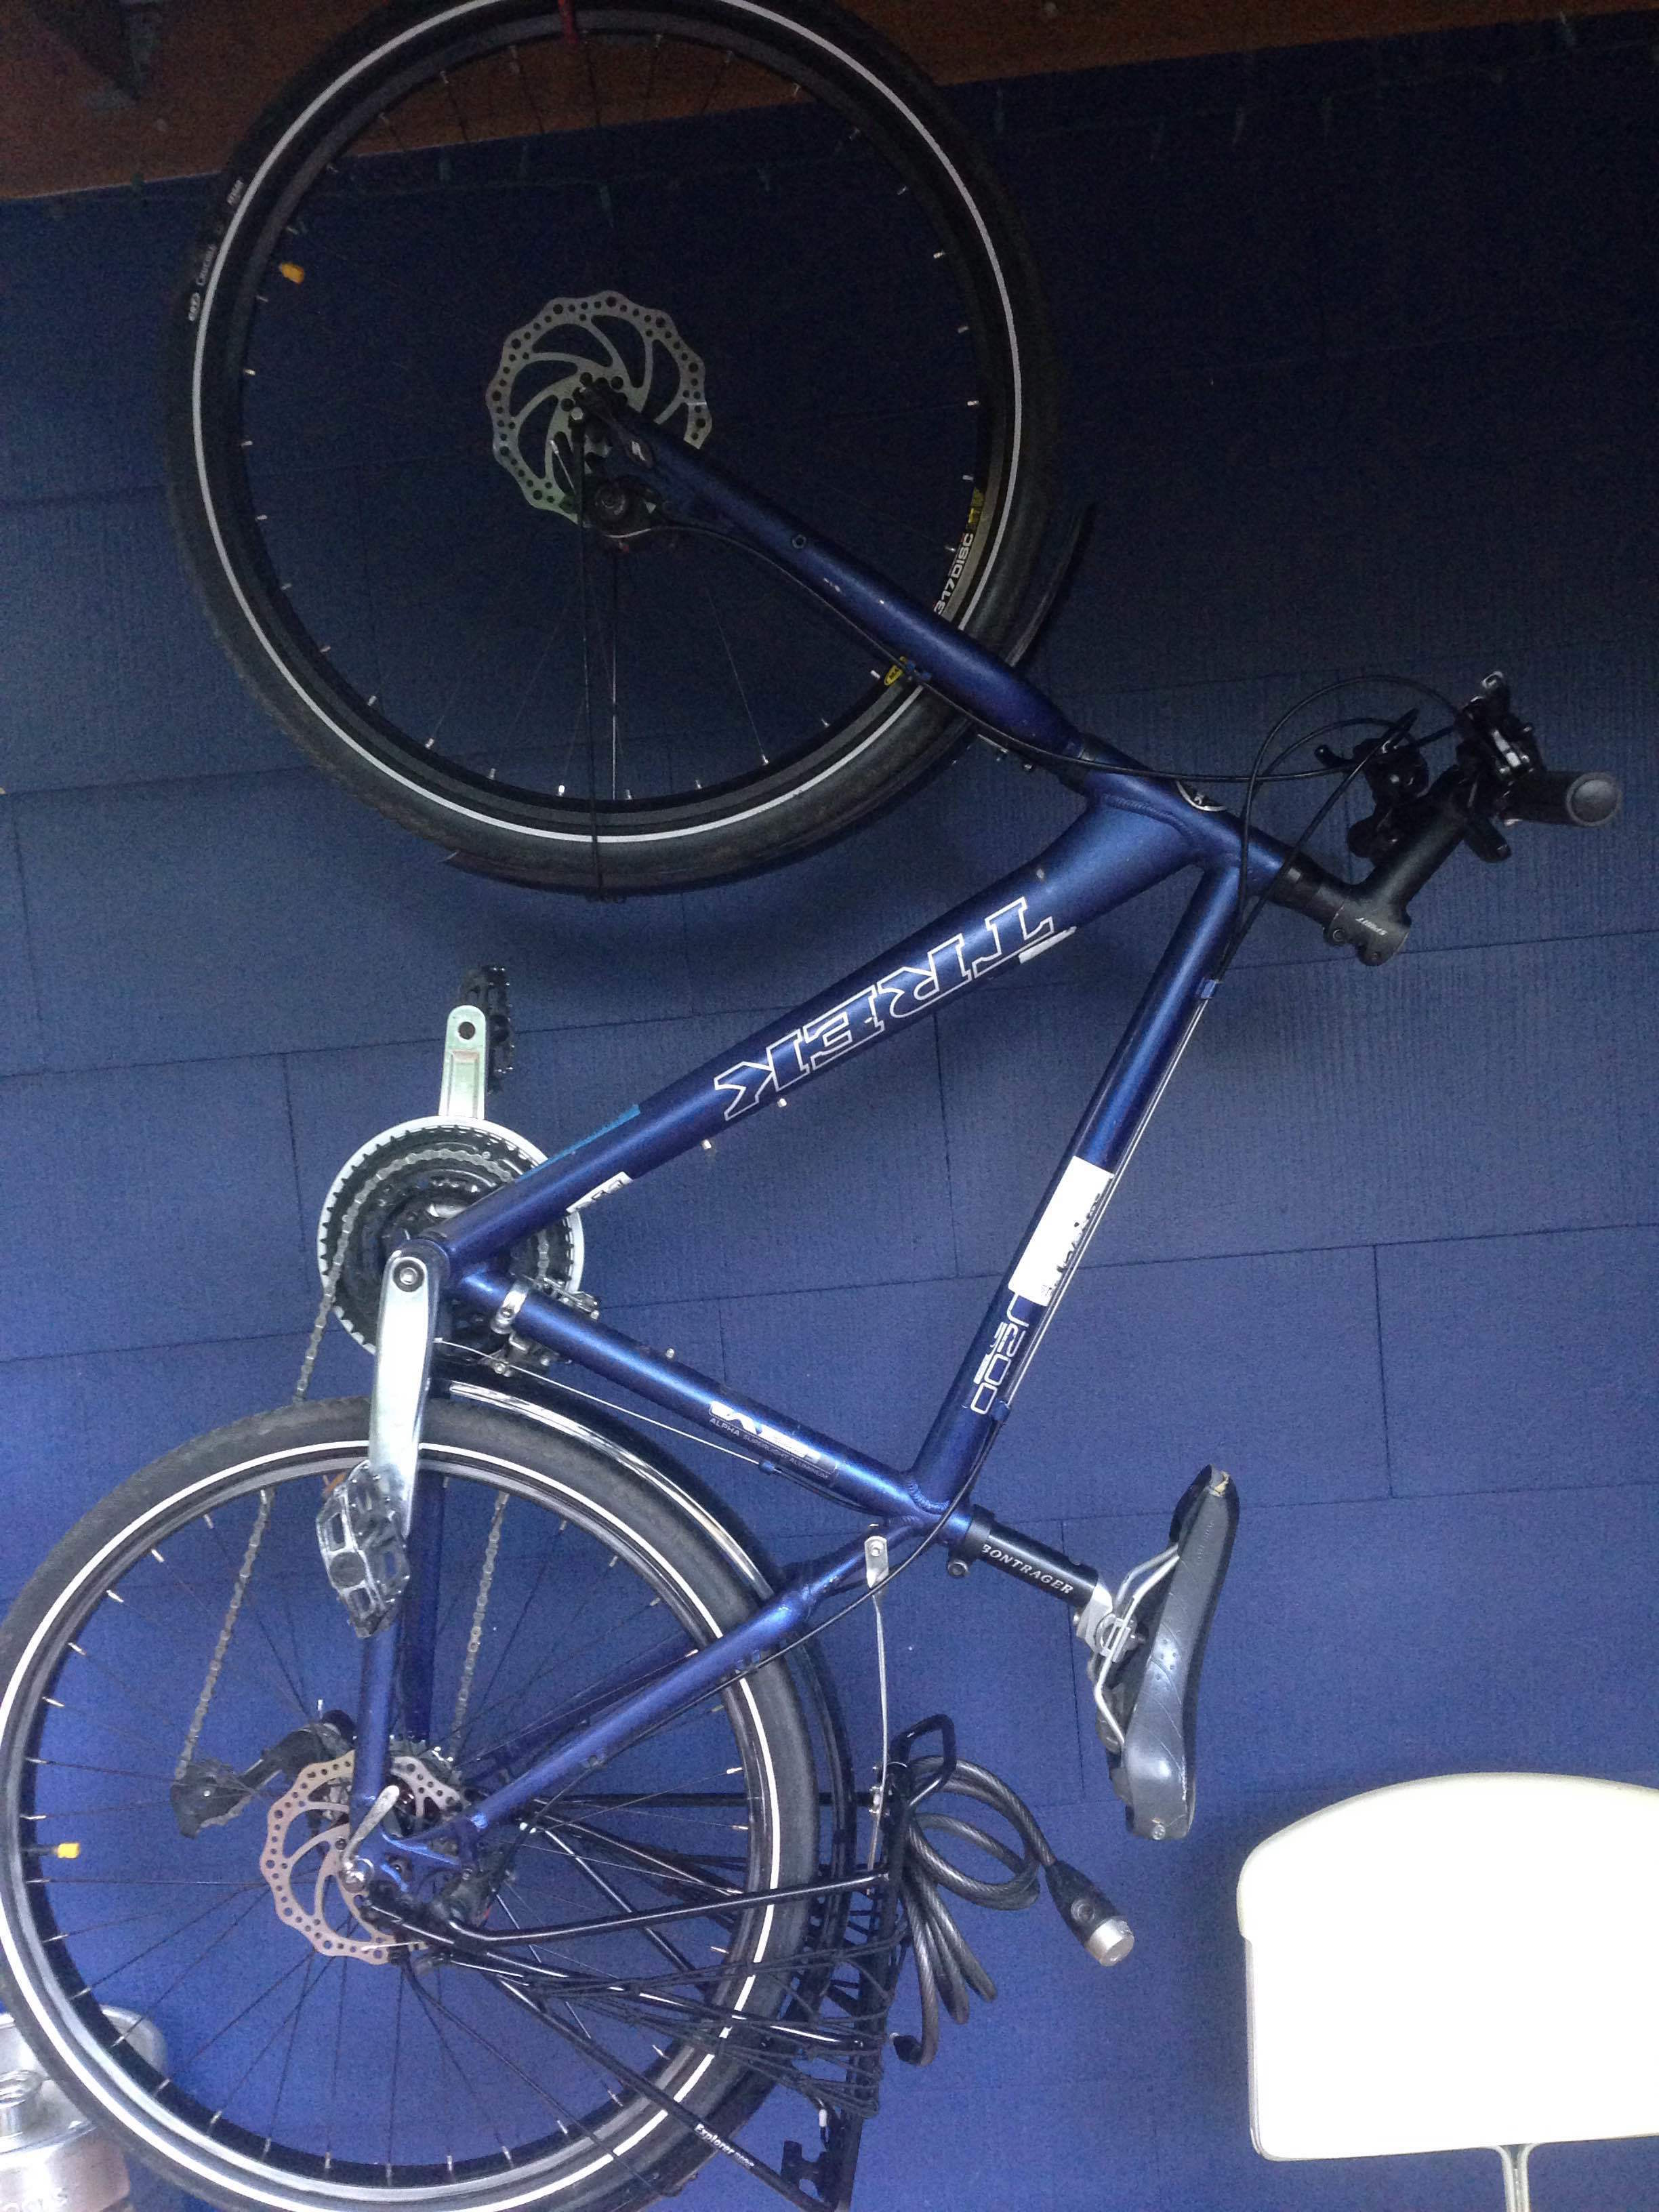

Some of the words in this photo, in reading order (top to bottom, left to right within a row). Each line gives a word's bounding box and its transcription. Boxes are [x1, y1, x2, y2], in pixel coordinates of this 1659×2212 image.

[714, 896, 1054, 1122] TREK
[710, 1418, 740, 1437] ALPHA
[981, 1544, 1074, 1594] BONTRAGER
[693, 2123, 735, 2155] Explorer
